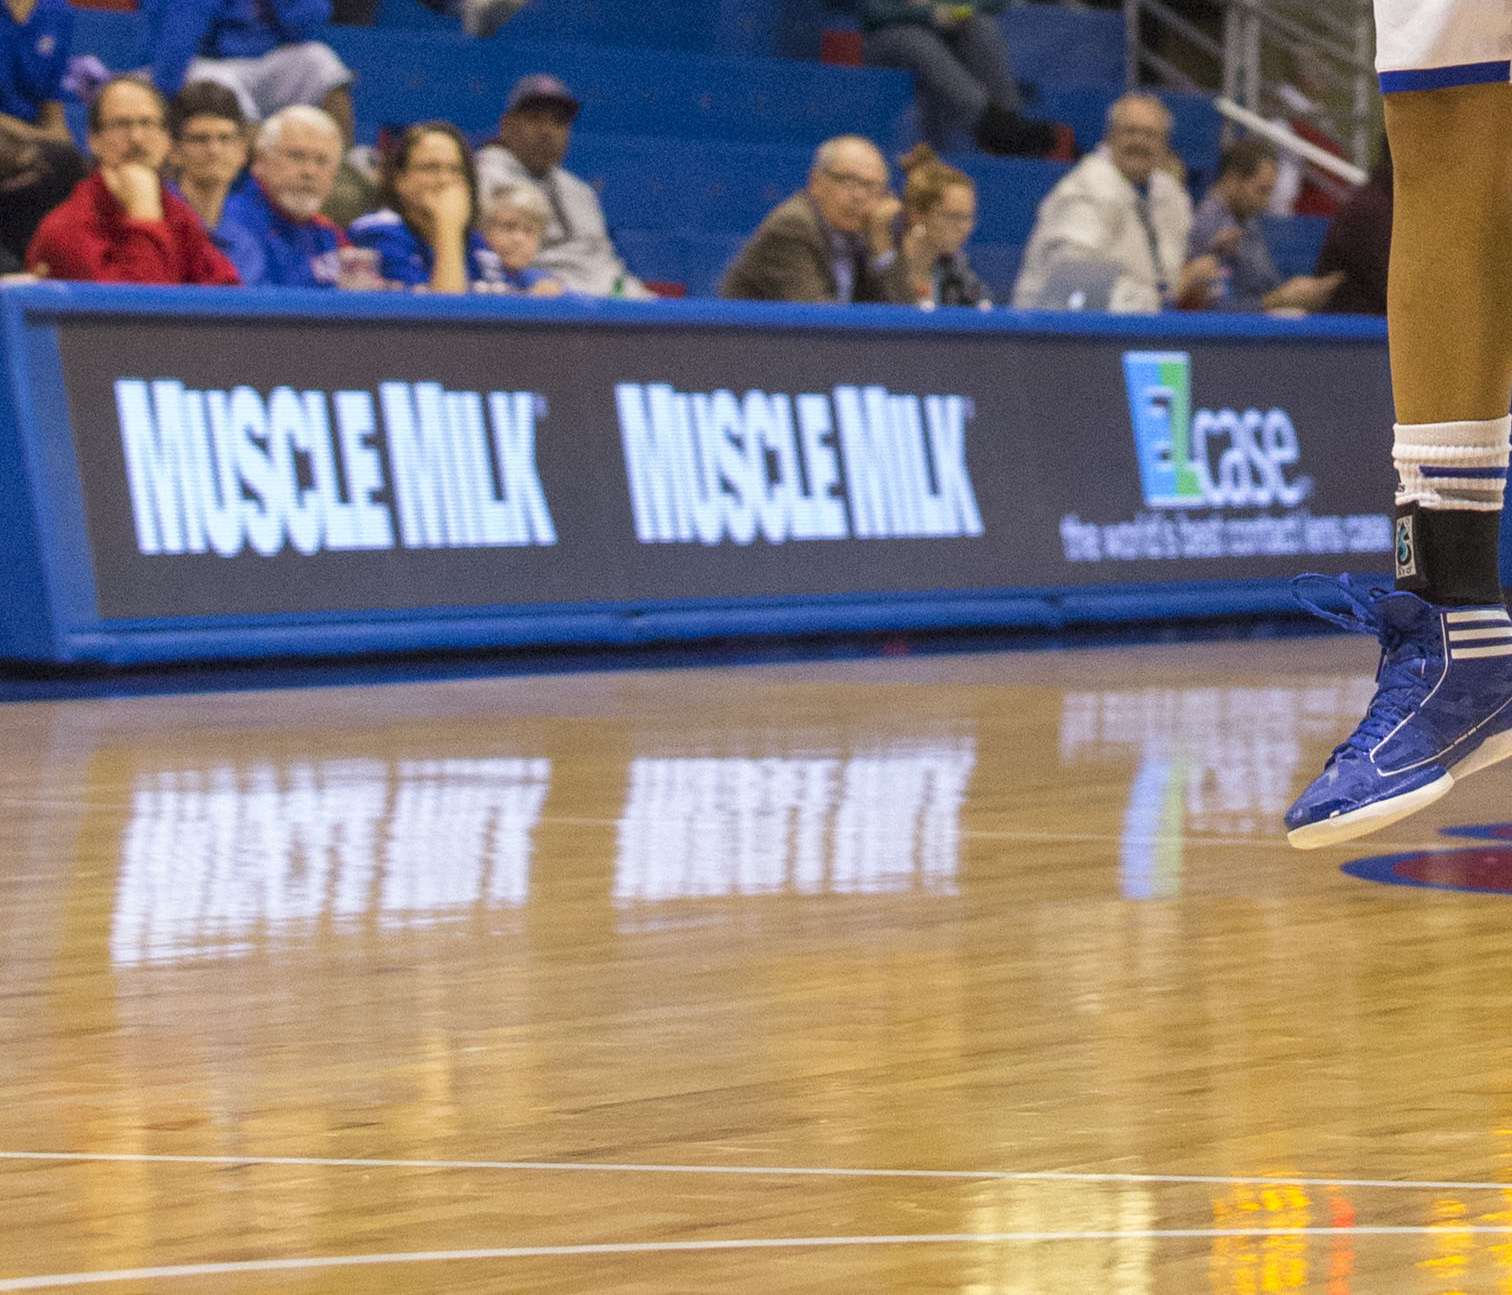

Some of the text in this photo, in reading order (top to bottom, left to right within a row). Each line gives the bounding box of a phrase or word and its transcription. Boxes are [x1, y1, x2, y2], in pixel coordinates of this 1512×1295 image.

[113, 379, 557, 558] MUSCLE MILK
[614, 383, 985, 546] MUSCLE MILK
